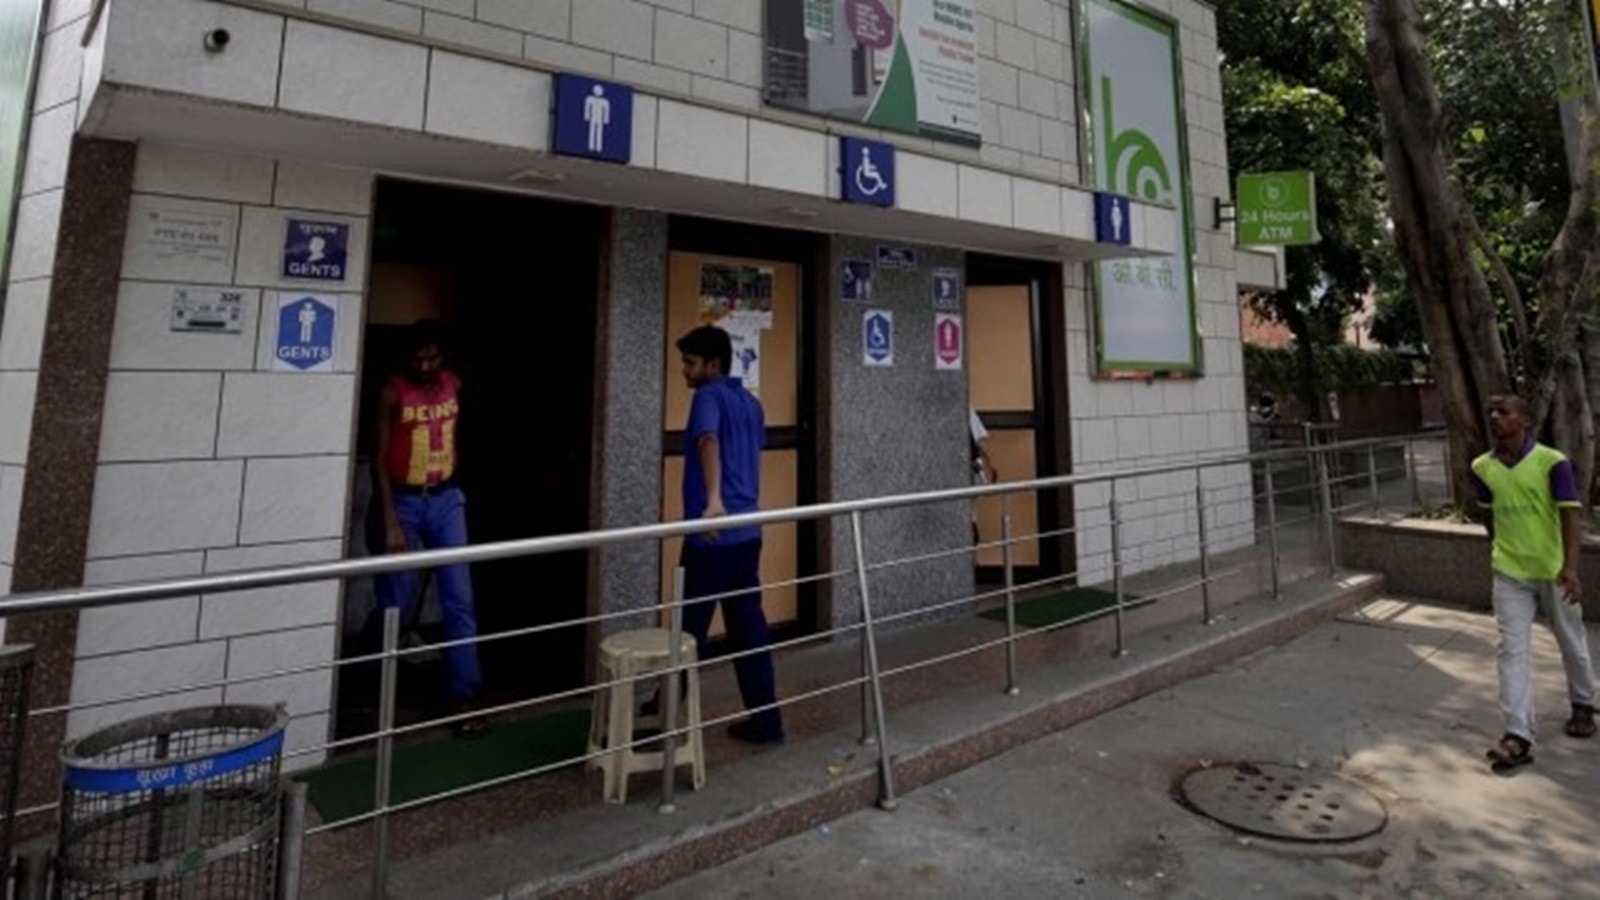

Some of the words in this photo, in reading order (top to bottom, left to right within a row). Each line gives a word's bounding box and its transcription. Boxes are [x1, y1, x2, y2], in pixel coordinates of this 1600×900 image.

[1262, 210, 1310, 223] Hours
[1259, 227, 1293, 240] ATM
[288, 261, 341, 278] GENTS
[279, 346, 330, 360] GENTS
